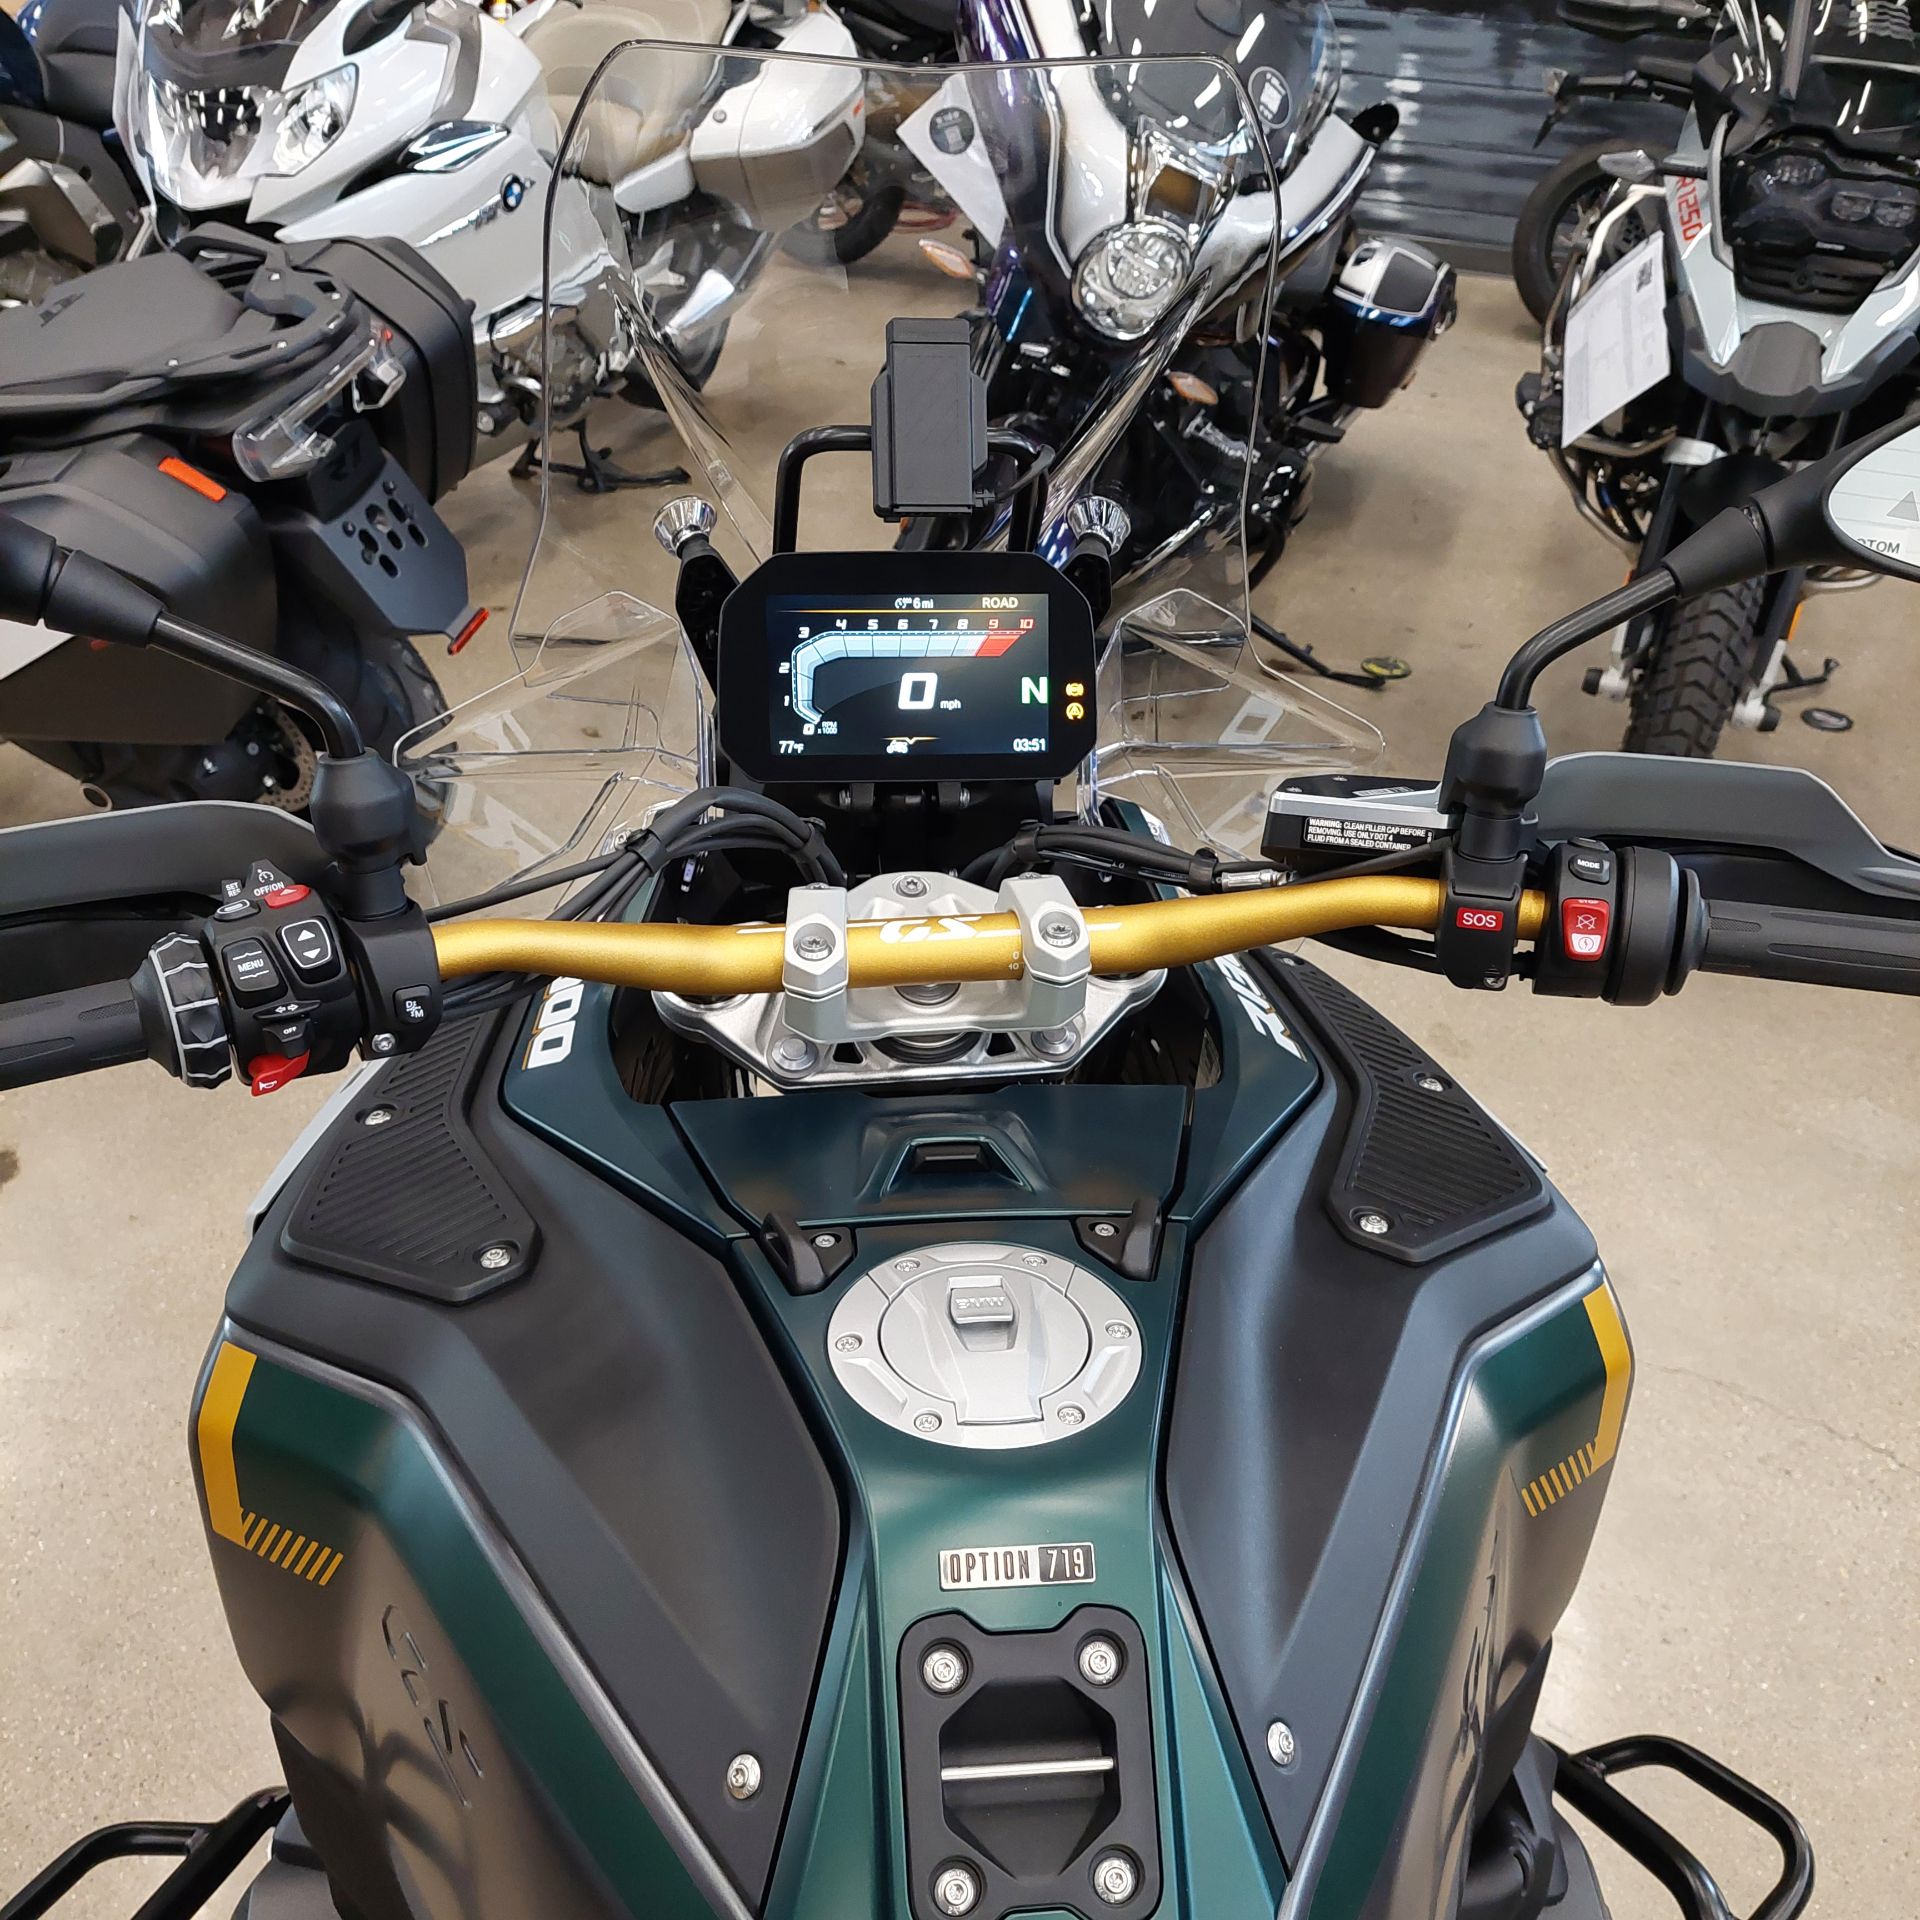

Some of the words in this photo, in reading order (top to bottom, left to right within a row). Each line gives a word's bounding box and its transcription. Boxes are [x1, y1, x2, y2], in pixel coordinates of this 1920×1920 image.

[982, 597, 1019, 609] ROAD
[835, 619, 848, 630] 4
[867, 619, 879, 630] 5
[897, 619, 909, 630] 6
[928, 619, 939, 630] 7
[957, 619, 969, 630] 8
[988, 619, 999, 629] 9
[1020, 619, 1034, 629] 10
[798, 626, 810, 639] 3
[778, 662, 791, 674] 2
[898, 672, 938, 710] 0
[940, 699, 962, 711] mph
[1021, 676, 1048, 704] N
[783, 695, 790, 707] 1
[802, 723, 815, 735] 0
[1012, 737, 1047, 752] 03:51
[1309, 818, 1343, 829] WARNING:
[1343, 821, 1365, 831] CLEAN
[1365, 823, 1387, 833] FILLER
[1386, 826, 1400, 834] CAP
[1400, 827, 1426, 837] BEFORE
[1307, 833, 1326, 842] FLUID
[1326, 836, 1345, 845] FROM
[1344, 837, 1350, 845] A
[1350, 839, 1375, 848] SEALED
[1343, 829, 1357, 838] USE
[1357, 830, 1374, 839] ONLY
[1374, 832, 1389, 841] DOT
[1577, 858, 1600, 869] MODE
[225, 882, 238, 891] SET
[253, 881, 285, 897] OFF/ON
[1462, 912, 1497, 928] SOS
[237, 958, 264, 973] MENU
[282, 1026, 297, 1035] OFF
[949, 1550, 1030, 1584] OPTION
[1046, 1547, 1085, 1578] 719
